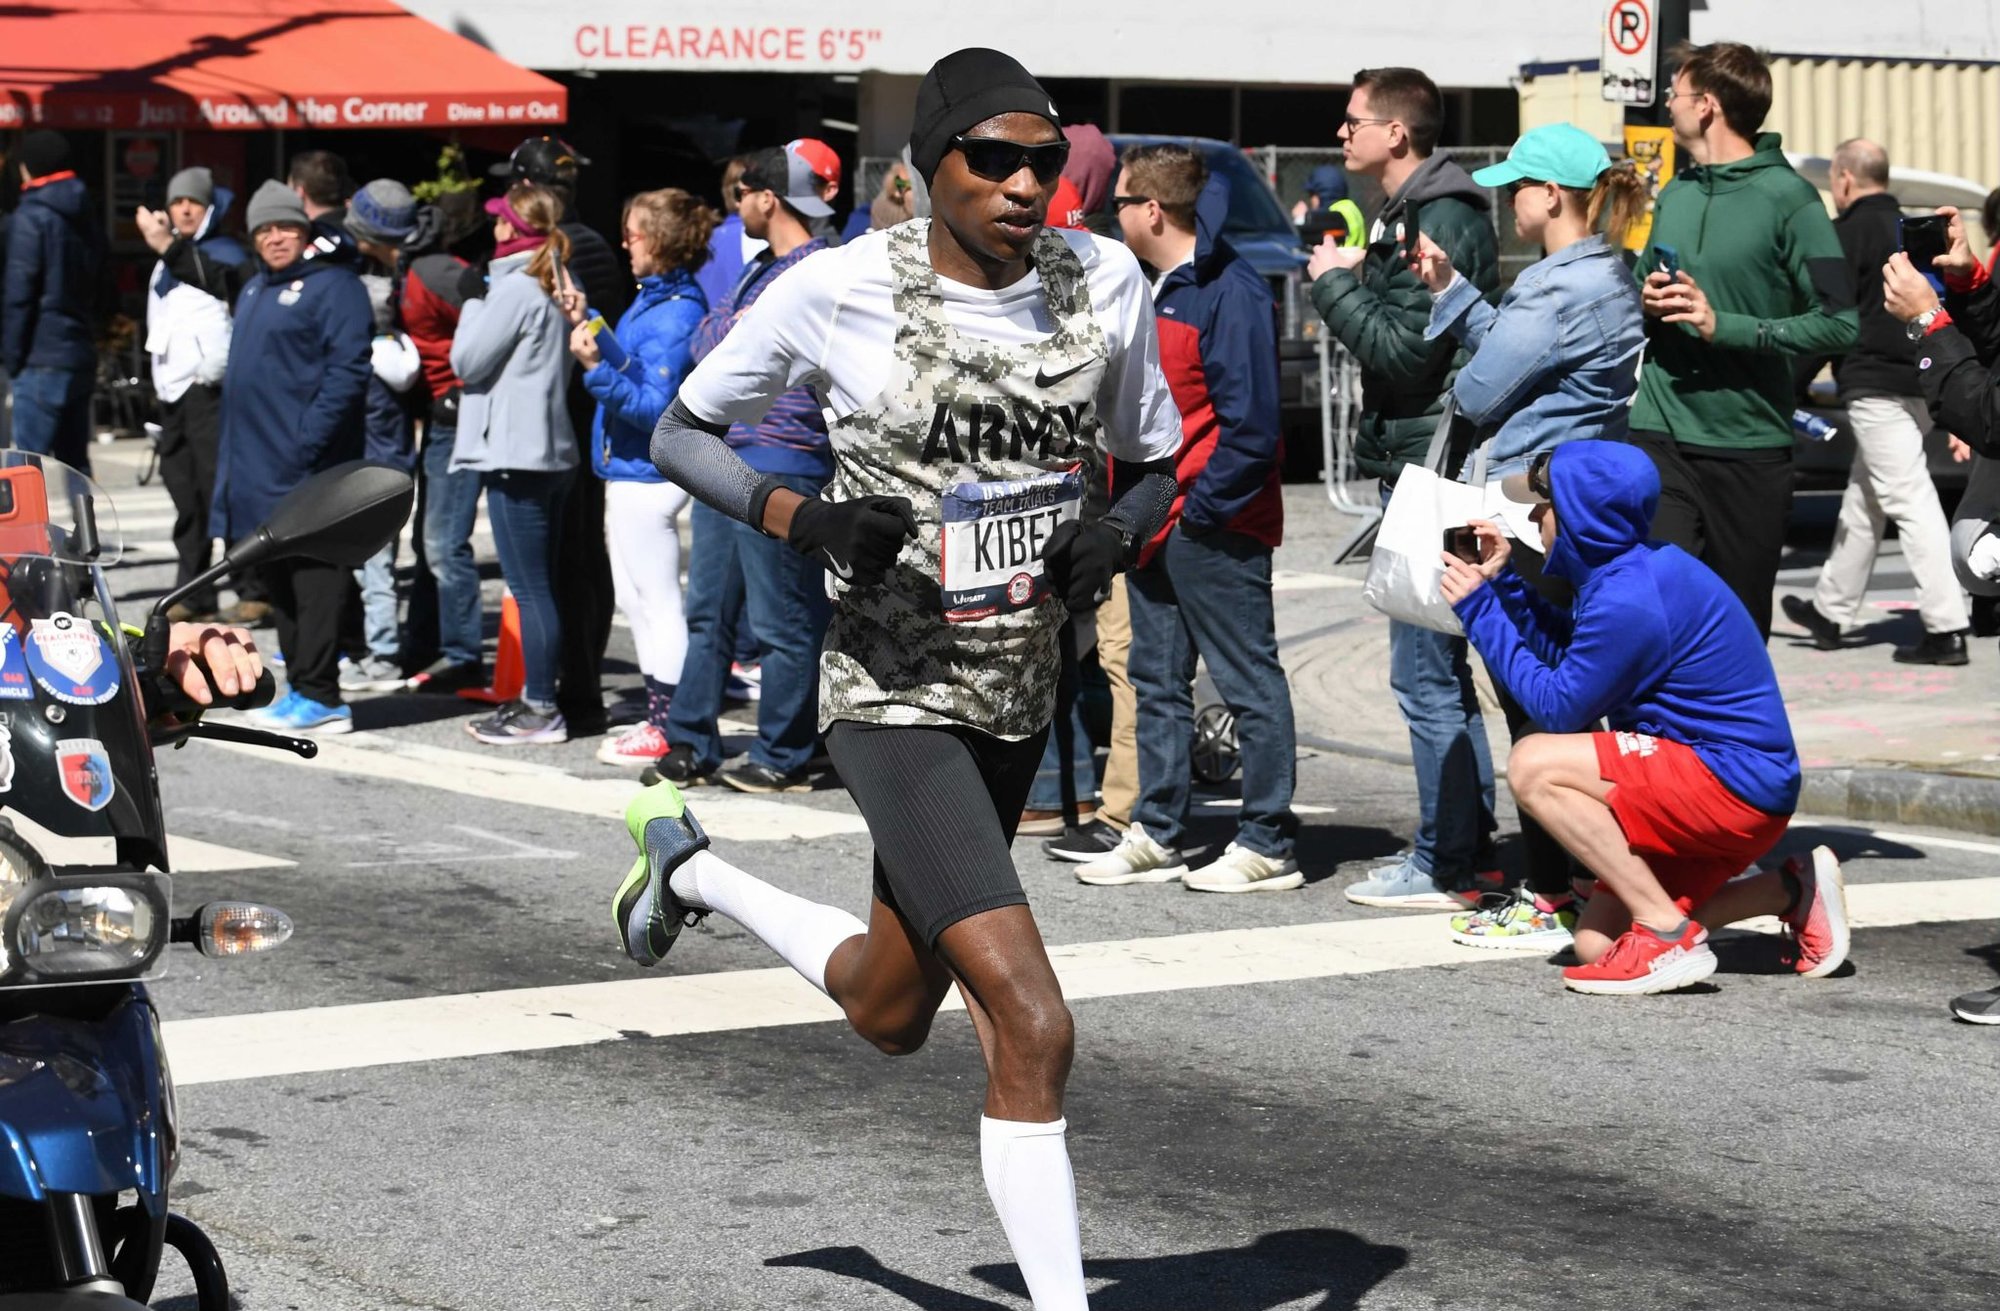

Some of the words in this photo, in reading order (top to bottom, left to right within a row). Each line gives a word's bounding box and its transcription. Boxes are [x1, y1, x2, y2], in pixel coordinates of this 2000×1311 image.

[1620, 11, 1640, 44] P
[575, 25, 805, 61] CLEARANCE
[818, 28, 882, 61] 6'5"
[138, 99, 187, 127] Just
[196, 97, 288, 124] Around
[297, 97, 337, 123] the
[343, 97, 428, 123] Corner
[448, 103, 485, 121] Dine
[488, 103, 505, 120] In
[507, 104, 525, 120] or
[527, 101, 559, 120] Out
[920, 401, 1090, 464] ARMY
[1008, 477, 1061, 498] OLYMPIC
[983, 498, 1015, 516] TEAM
[1018, 489, 1057, 512] TRIALS
[974, 507, 1063, 573] KIBET
[36, 632, 98, 643] PEACHTREE
[56, 691, 97, 705] OFFICIAL
